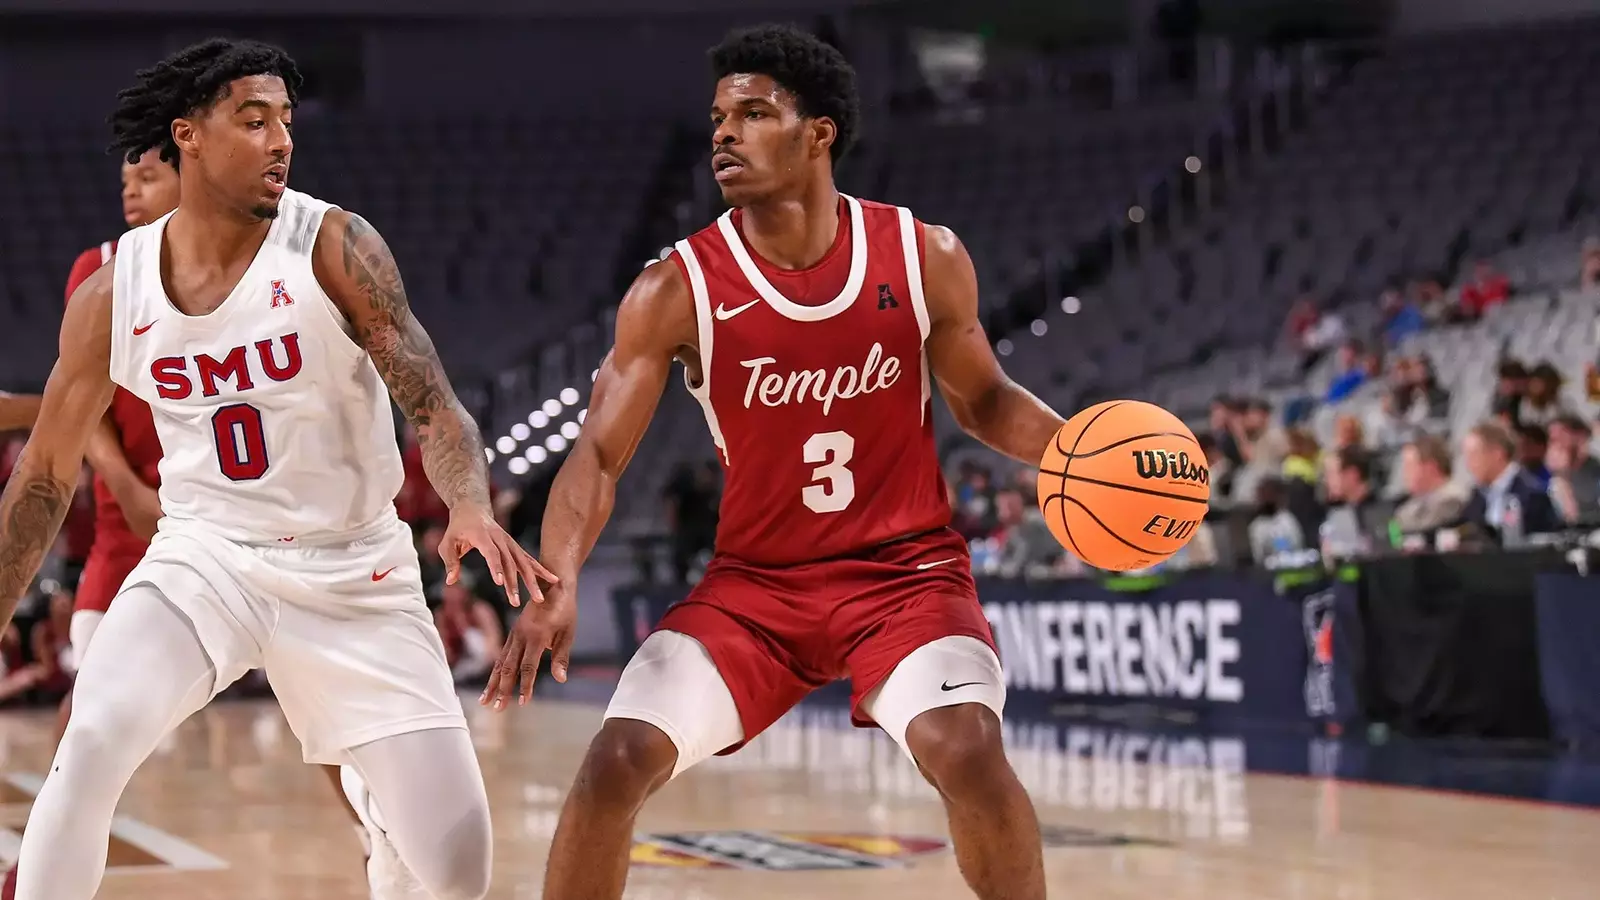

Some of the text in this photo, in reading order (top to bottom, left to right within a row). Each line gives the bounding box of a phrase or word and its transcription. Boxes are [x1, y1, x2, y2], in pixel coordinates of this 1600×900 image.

[270, 279, 295, 309] A
[877, 283, 899, 311] A
[150, 332, 303, 400] SMU
[740, 342, 902, 416] Temple
[211, 402, 270, 482] 0
[802, 430, 855, 514] 3
[983, 600, 1244, 702] ONFERENCE
